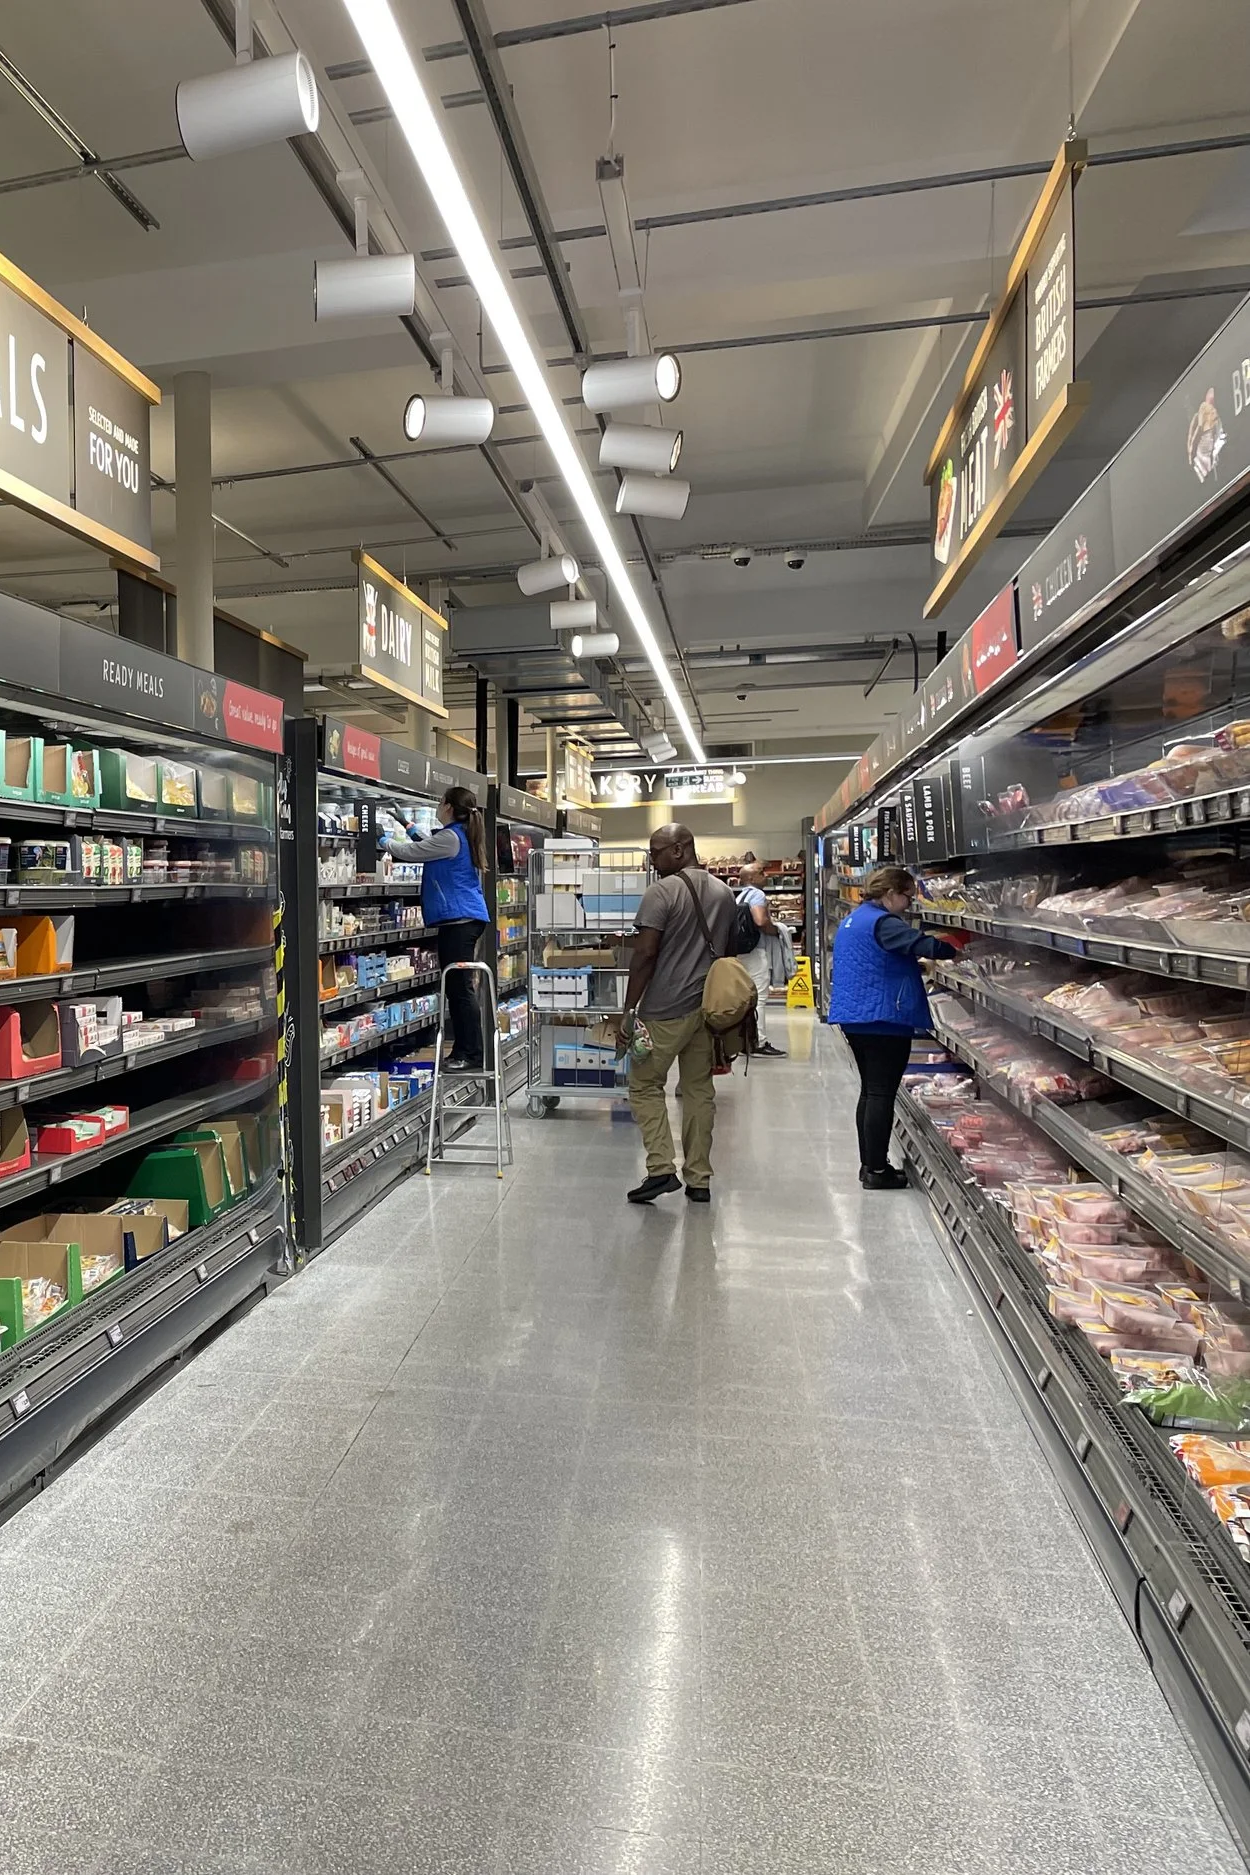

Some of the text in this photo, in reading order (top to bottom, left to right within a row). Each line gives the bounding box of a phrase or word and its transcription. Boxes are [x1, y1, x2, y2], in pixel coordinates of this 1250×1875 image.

[1035, 264, 1067, 352] BRITISH
[1035, 315, 1067, 401] FARMERS
[88, 405, 139, 455] SELECTED AND MADE
[90, 431, 139, 494] FOR YOU
[960, 425, 988, 540] MEAT
[381, 603, 412, 667] DAIRY
[103, 659, 164, 698] READY MEALS
[425, 662, 440, 693] MILK
[922, 785, 932, 809] LAMB
[961, 766, 972, 790] BEEF
[361, 804, 369, 833] CHEESE
[904, 803, 915, 842] SAUSAGES
[925, 819, 935, 843] PORK
